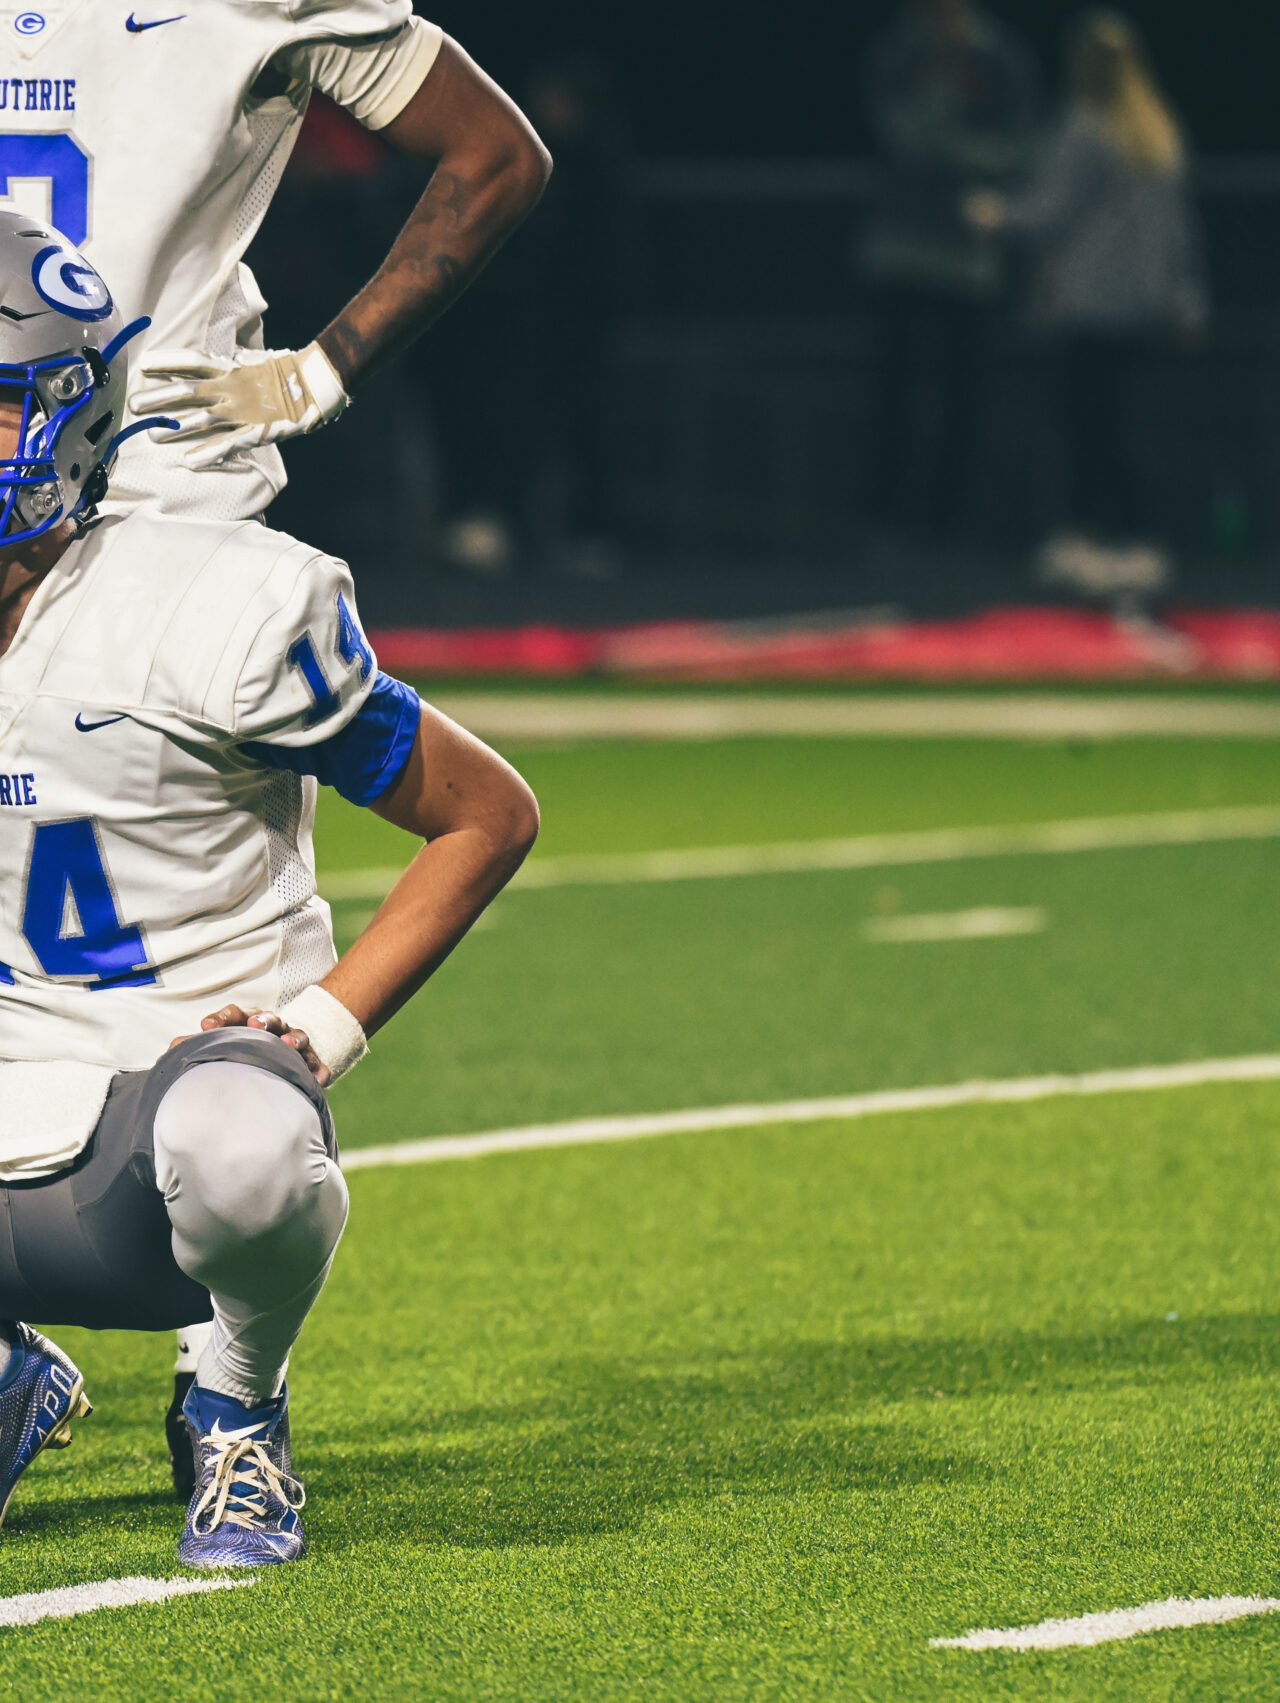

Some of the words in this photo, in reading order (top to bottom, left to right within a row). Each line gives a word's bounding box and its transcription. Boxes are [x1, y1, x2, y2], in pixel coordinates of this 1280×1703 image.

[15, 12, 45, 34] G
[32, 245, 113, 322] G
[286, 585, 373, 731] 14
